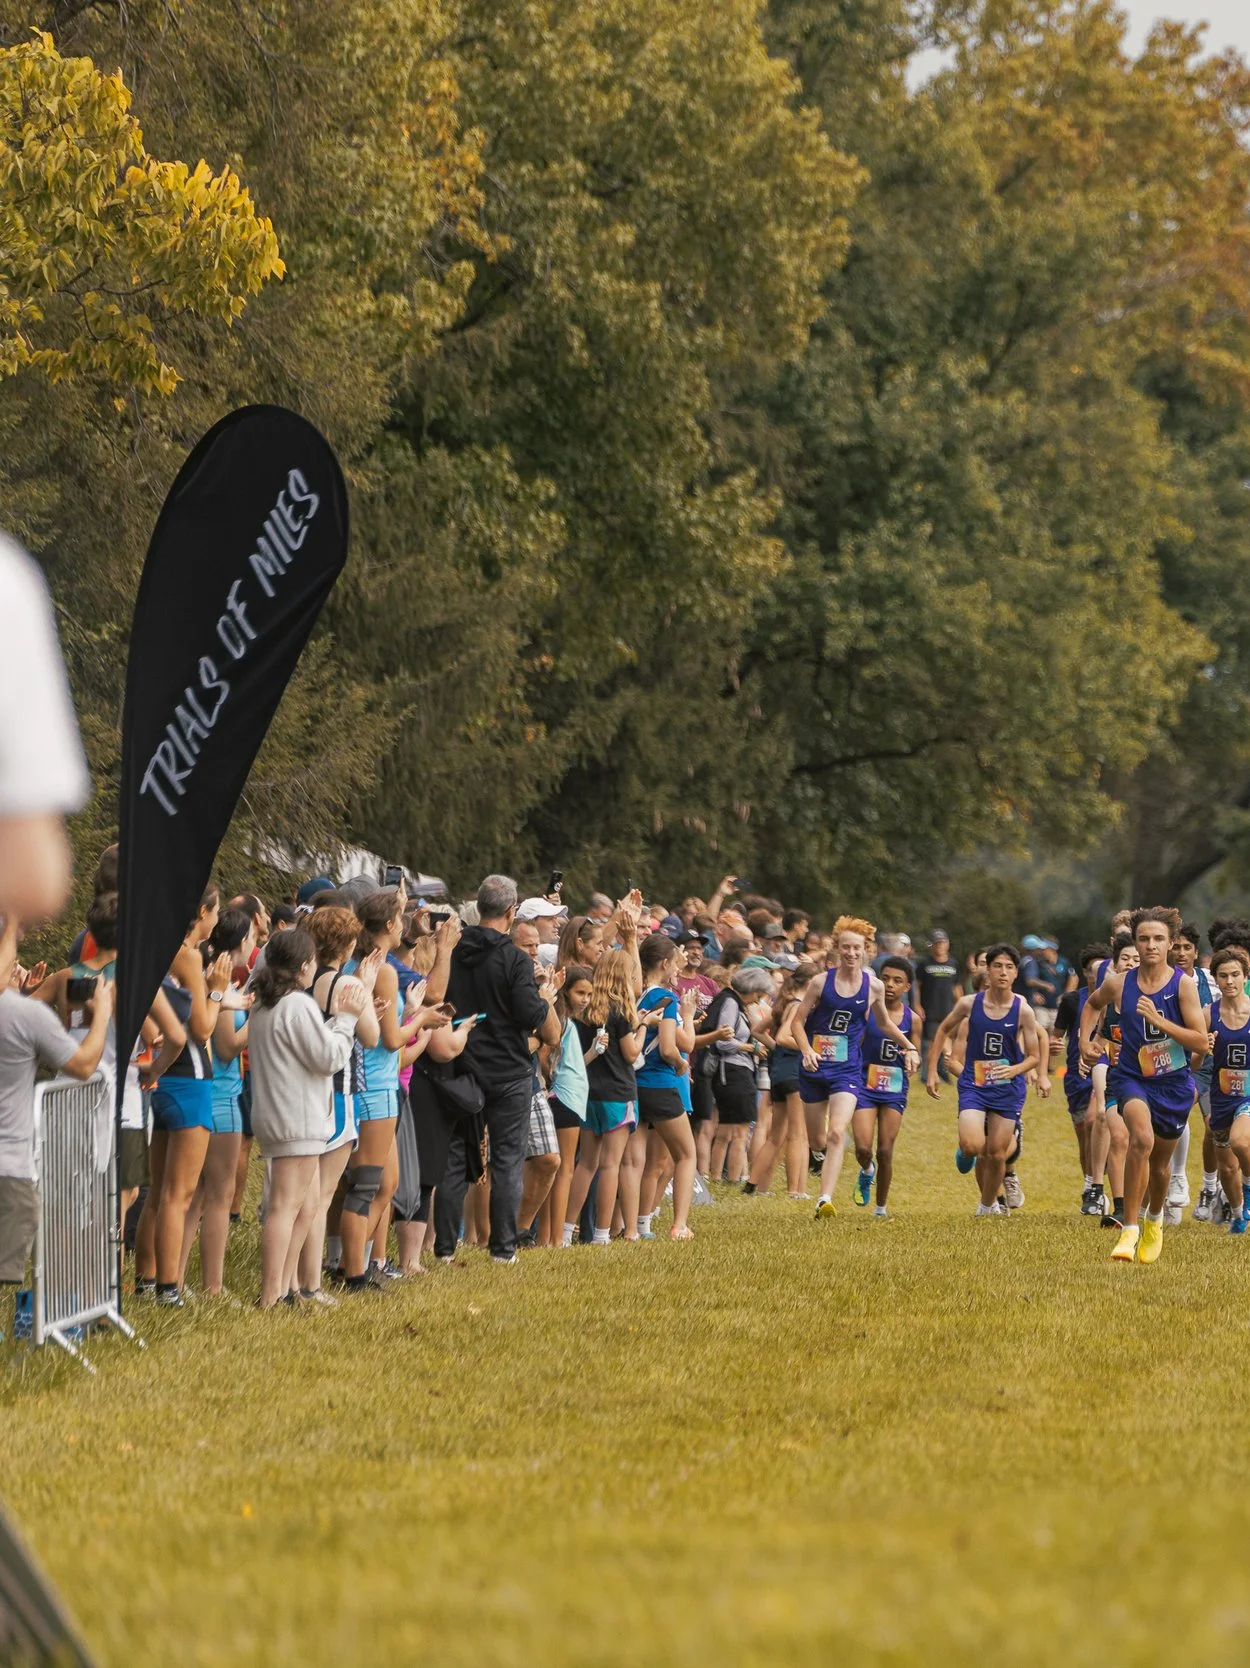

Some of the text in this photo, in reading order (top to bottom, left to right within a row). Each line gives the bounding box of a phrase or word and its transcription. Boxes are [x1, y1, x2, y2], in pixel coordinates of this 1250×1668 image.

[139, 468, 319, 816] TRIALS OF MILES
[829, 1009, 852, 1034] G
[880, 1038, 899, 1062] G
[983, 1031, 1003, 1056] G
[1227, 1043, 1247, 1067] G
[1153, 1052, 1172, 1068] 288
[1231, 1079, 1245, 1091] 281
